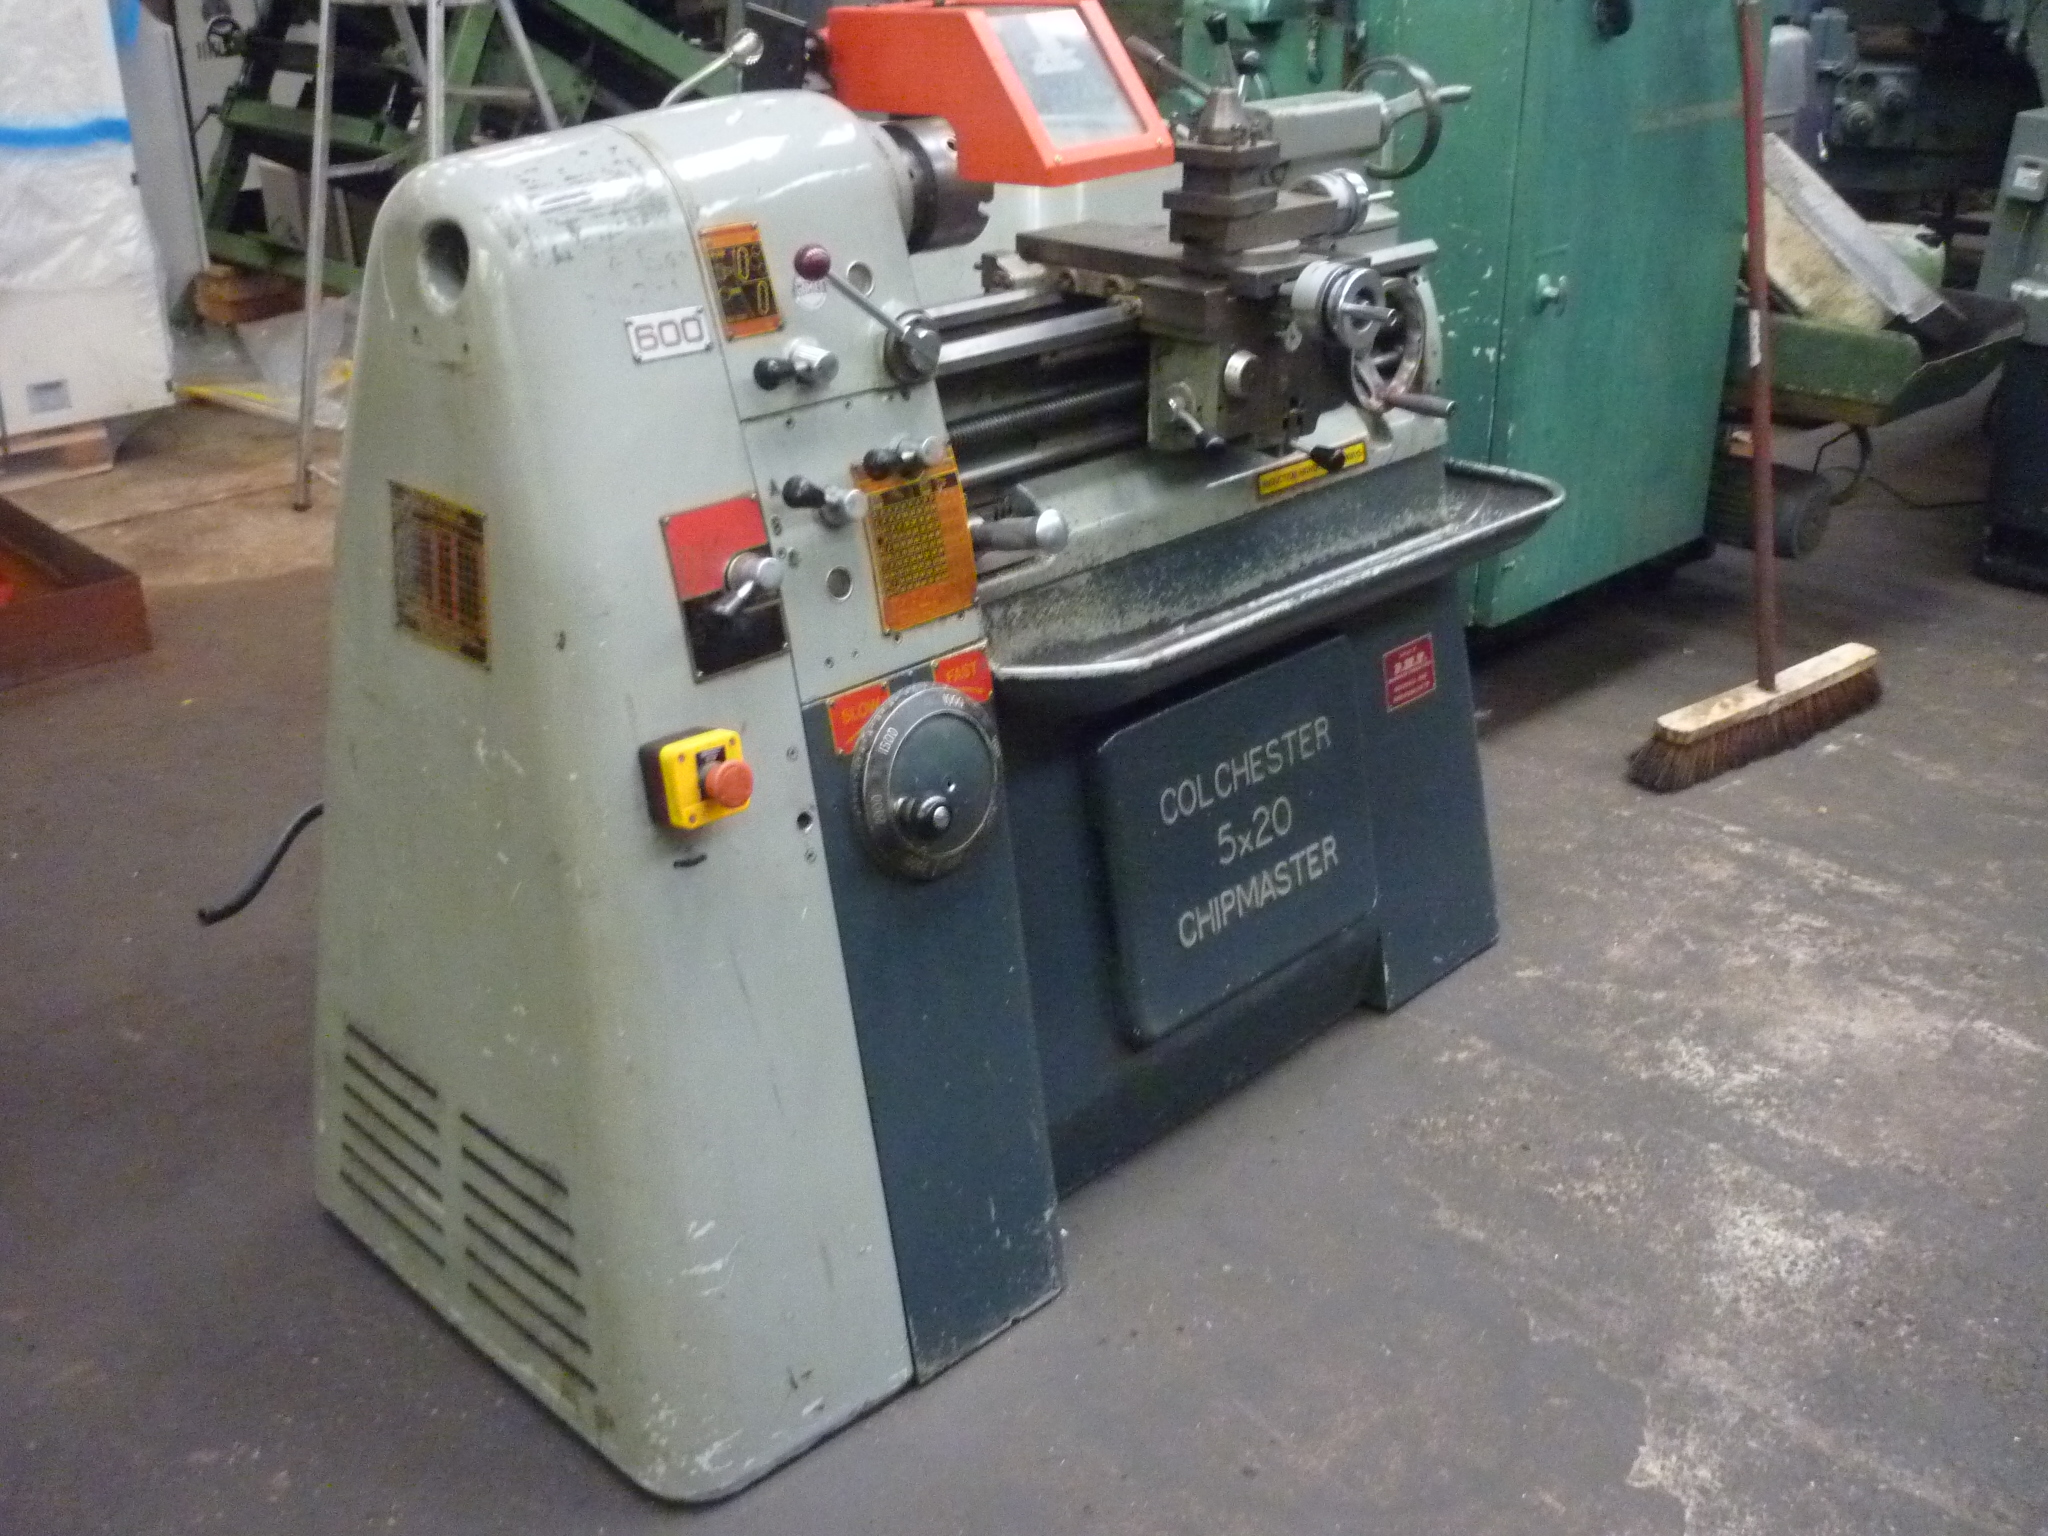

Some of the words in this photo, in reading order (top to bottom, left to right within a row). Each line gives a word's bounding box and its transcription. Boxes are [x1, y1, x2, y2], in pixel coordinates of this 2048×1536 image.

[634, 317, 705, 352] 600
[1159, 715, 1333, 826] COLCHESTER
[1216, 795, 1293, 866] 5x20
[1177, 834, 1340, 949] CHIPMASTER
